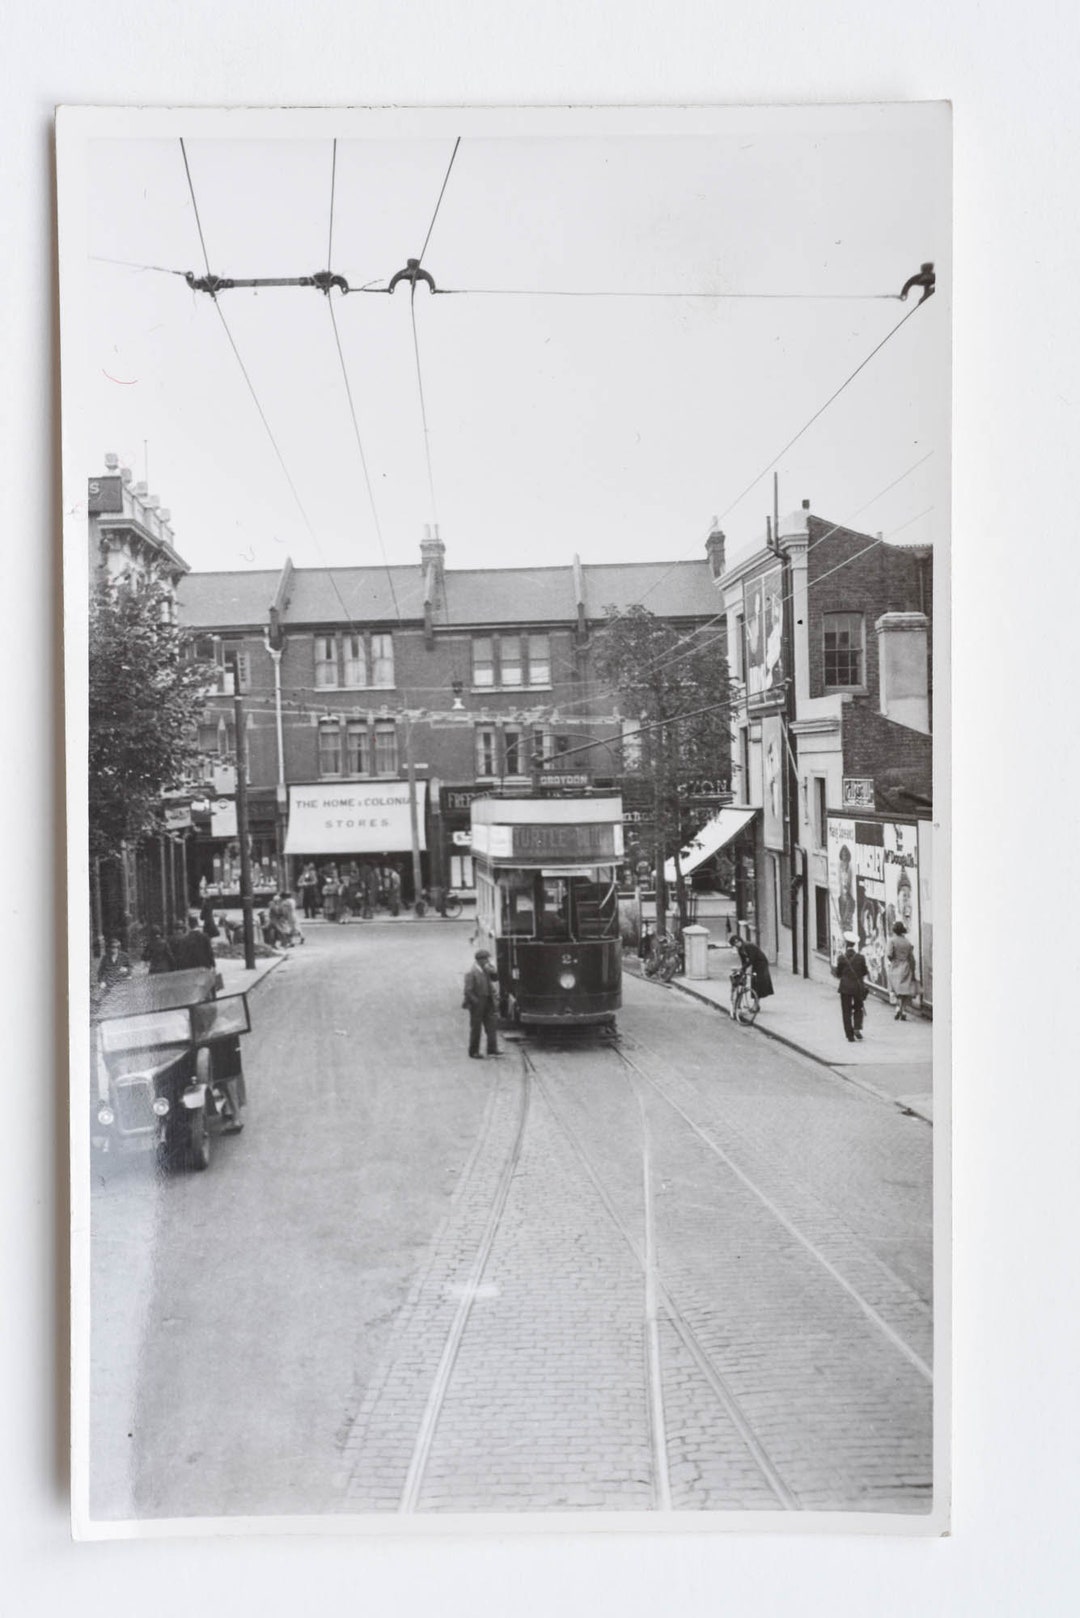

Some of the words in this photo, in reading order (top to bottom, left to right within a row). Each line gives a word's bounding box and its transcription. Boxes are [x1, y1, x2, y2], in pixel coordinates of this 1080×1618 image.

[540, 775, 588, 785] CROYDON
[295, 800, 319, 808] THE
[323, 798, 355, 807] HOME
[325, 818, 390, 828] STORES
